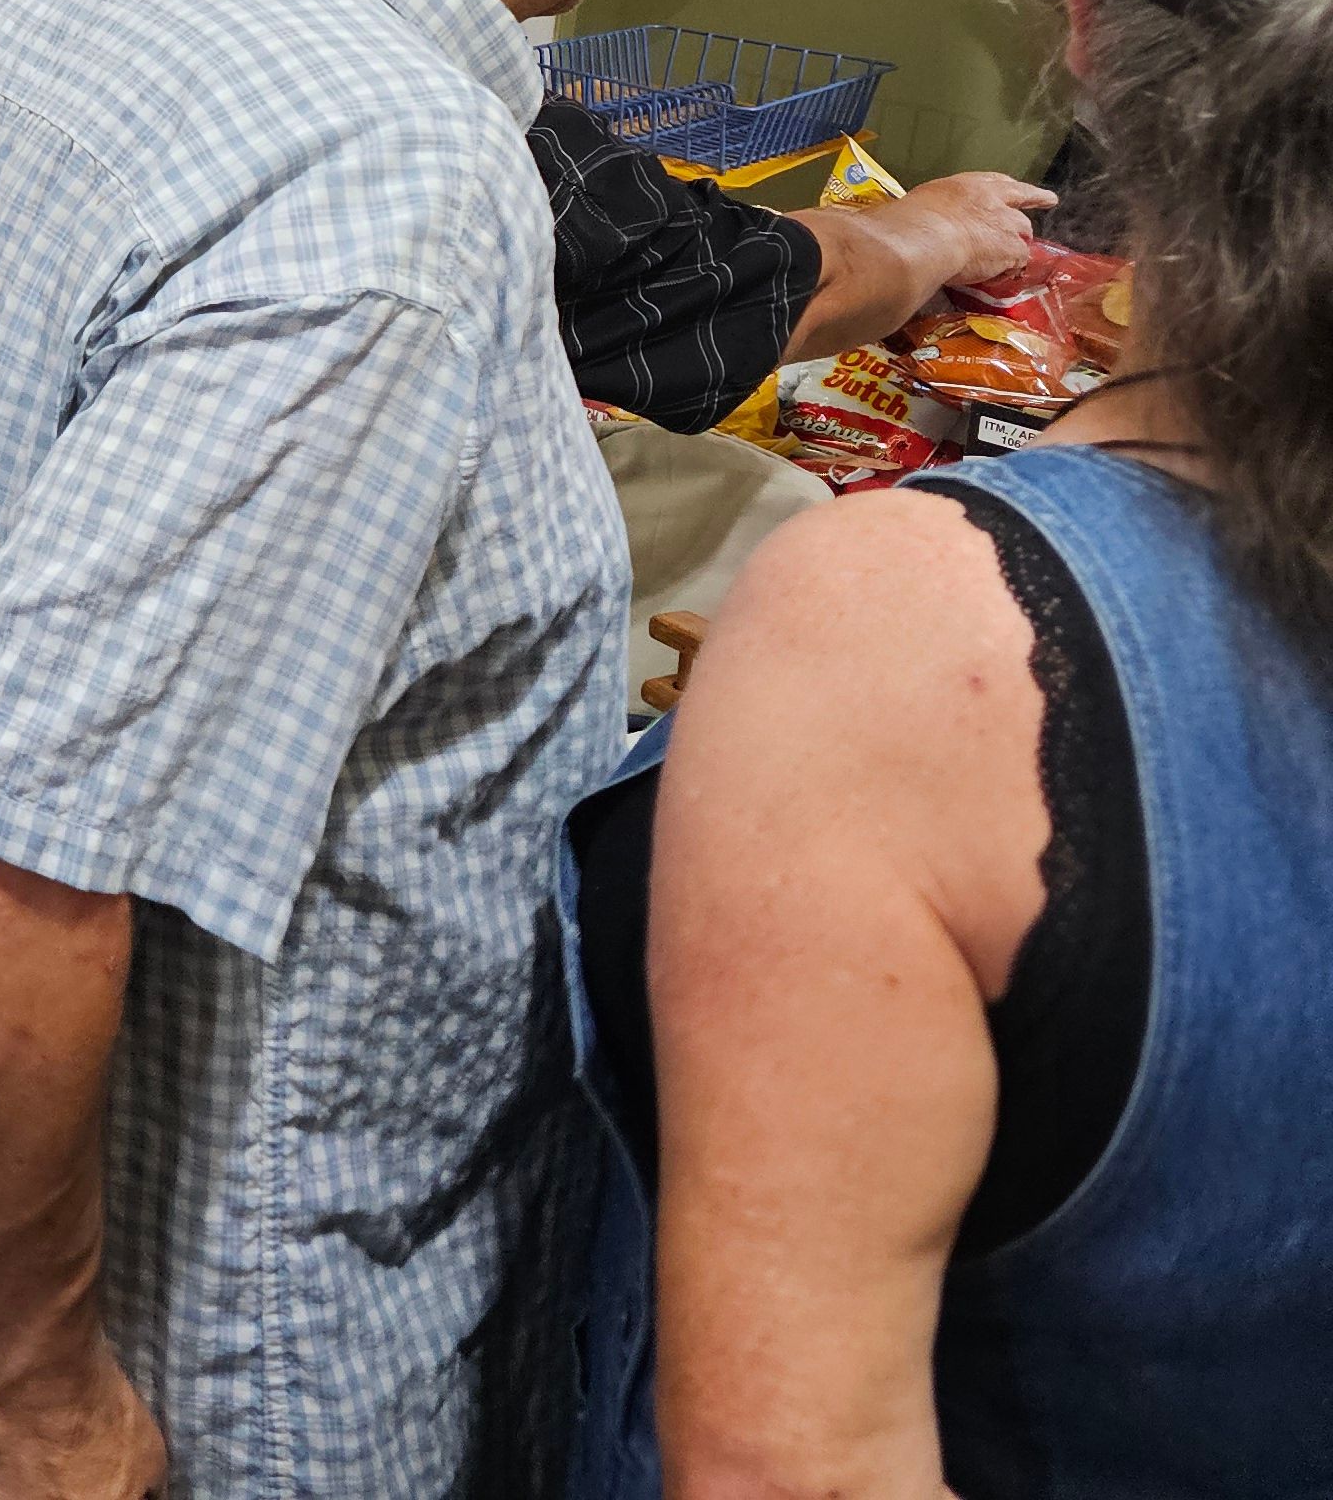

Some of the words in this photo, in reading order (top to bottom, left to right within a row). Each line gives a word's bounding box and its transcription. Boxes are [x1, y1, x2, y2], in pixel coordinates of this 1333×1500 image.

[822, 367, 909, 421] Dutch
[780, 408, 881, 448] Ketchup
[985, 421, 1008, 435] ITM.
[1019, 431, 1037, 440] AR
[1001, 436, 1027, 448] 106
